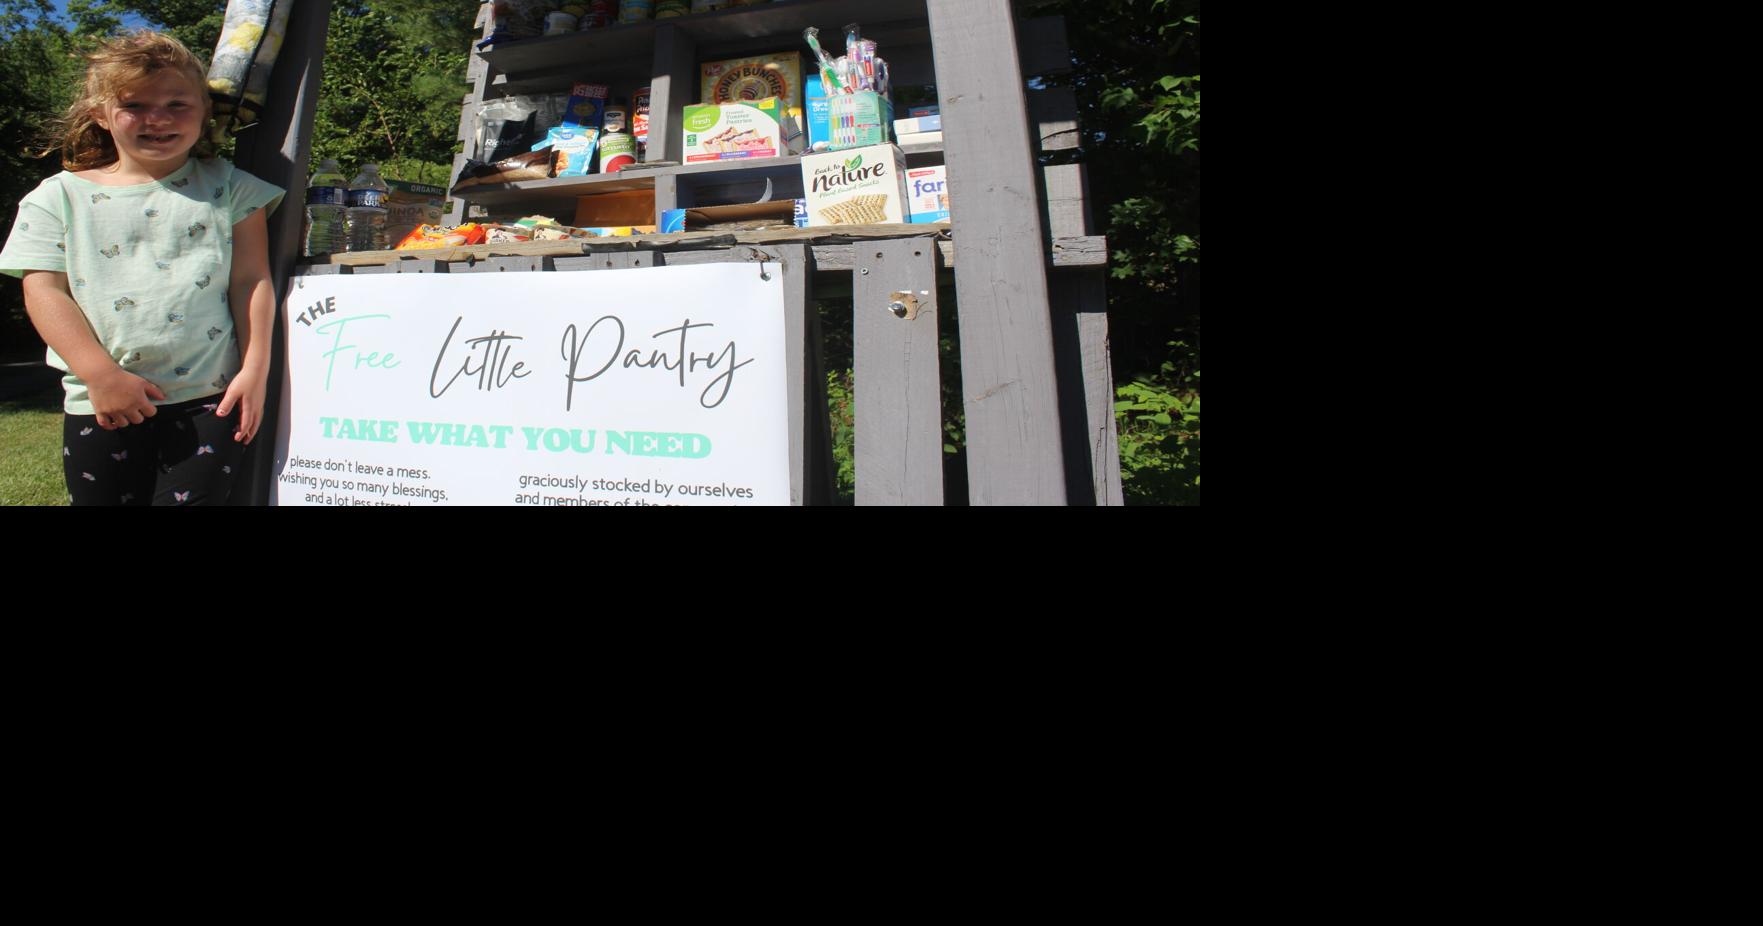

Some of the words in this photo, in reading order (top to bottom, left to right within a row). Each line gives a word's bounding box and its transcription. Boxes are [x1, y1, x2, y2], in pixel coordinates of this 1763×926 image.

[719, 71, 741, 100] HONEY
[743, 67, 782, 97] BUNCHES
[410, 184, 444, 195] ORGANIC
[812, 162, 885, 193] nature
[913, 180, 945, 197] far
[296, 296, 336, 328] THE
[315, 313, 401, 392] Free
[429, 315, 532, 399] Little
[561, 314, 755, 412] Pantry
[319, 416, 400, 444] TAKE
[406, 420, 513, 449] WHAT
[521, 426, 595, 453] YOU
[605, 429, 713, 460] NEED
[290, 456, 322, 469] please
[324, 458, 352, 473] don't
[355, 461, 384, 476] leave
[387, 468, 394, 477] a
[397, 468, 431, 479] mess.
[279, 471, 317, 489] wishing
[320, 477, 339, 490] you
[342, 480, 354, 490] so
[357, 481, 389, 496] many
[519, 473, 588, 493] graciously
[592, 477, 650, 493] stocked
[655, 479, 674, 498] by
[678, 482, 754, 499] ourselves
[305, 492, 324, 504] and
[326, 496, 332, 505] a
[334, 493, 349, 506] lot
[514, 492, 540, 505] and
[543, 493, 609, 506] members
